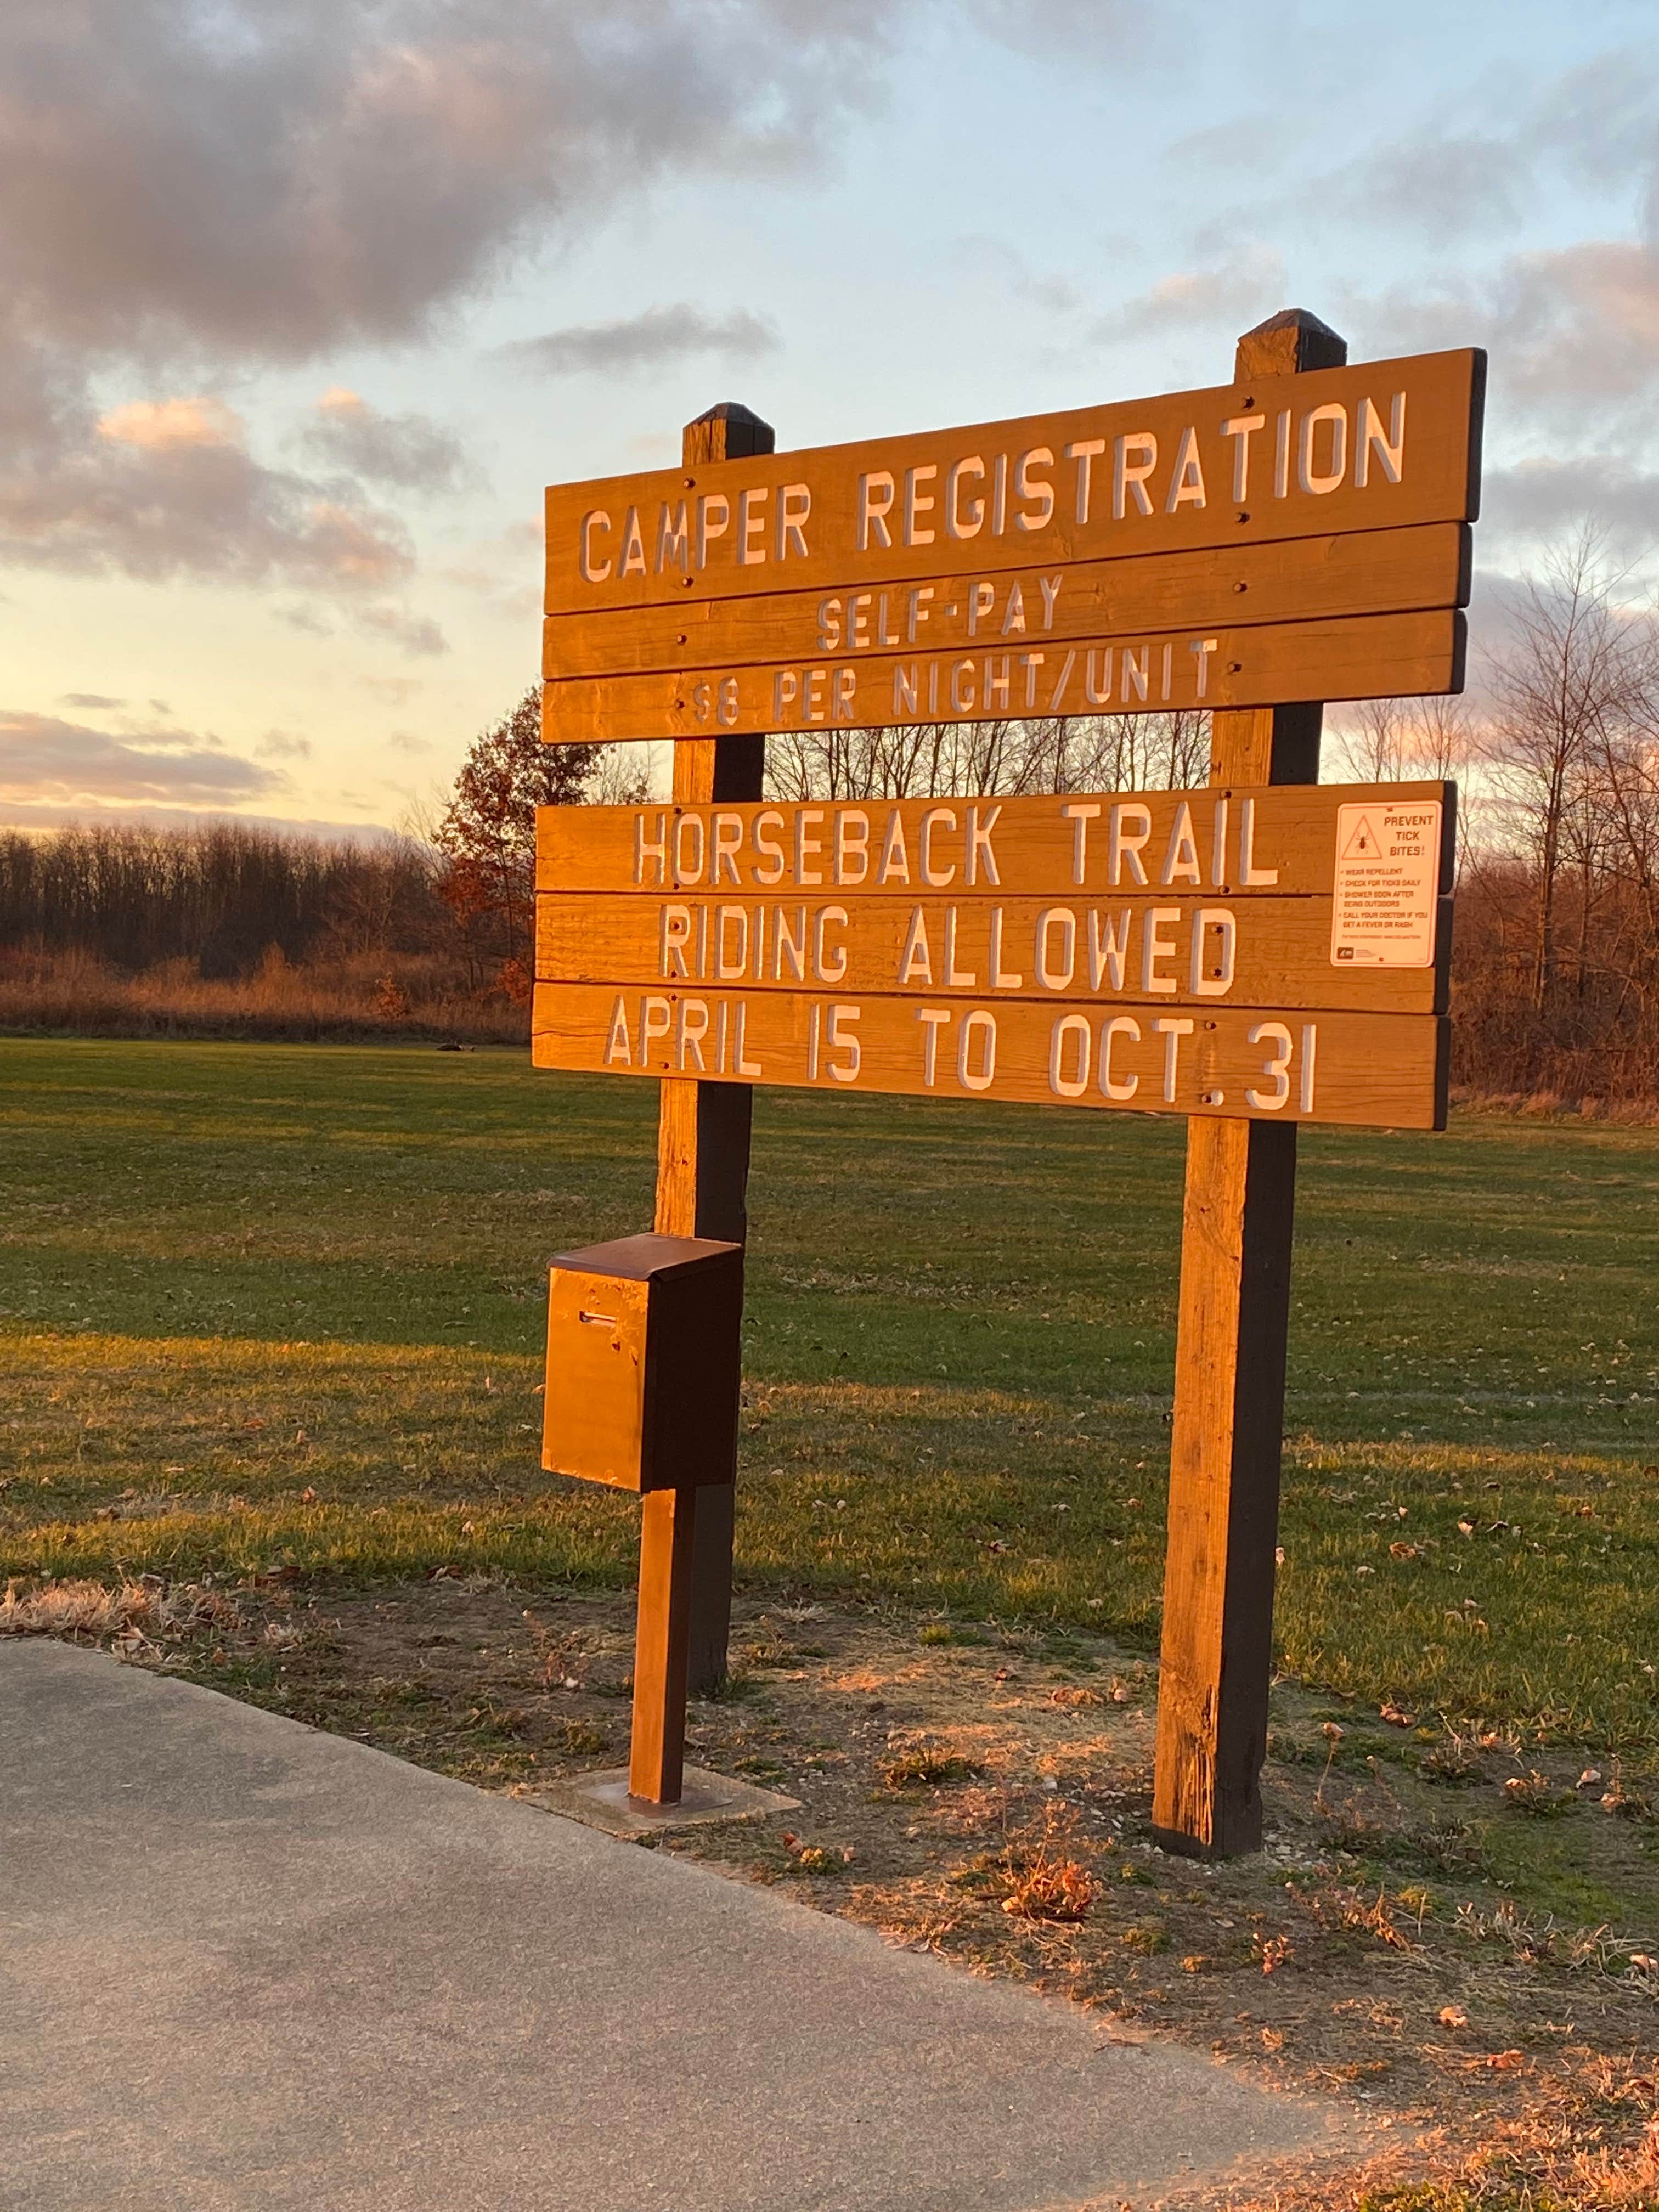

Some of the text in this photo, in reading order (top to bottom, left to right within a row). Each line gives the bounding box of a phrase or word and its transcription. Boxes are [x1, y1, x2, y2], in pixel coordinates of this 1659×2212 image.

[578, 392, 1406, 583] CAMPER REGISTRATION
[817, 574, 1063, 651] SELF-PAY
[694, 677, 738, 726] $8
[774, 668, 855, 721] PER
[635, 797, 1279, 887] HORSEBACK TRAIL
[1384, 815, 1434, 826] PREVENT
[1390, 846, 1425, 856] BITES!
[1396, 831, 1420, 841] TICK
[658, 904, 1238, 996] RIDING ALLOWED
[605, 995, 761, 1076] APRIL
[809, 1003, 861, 1082] 15
[916, 1008, 997, 1089] TO
[1245, 1022, 1316, 1113] 31
